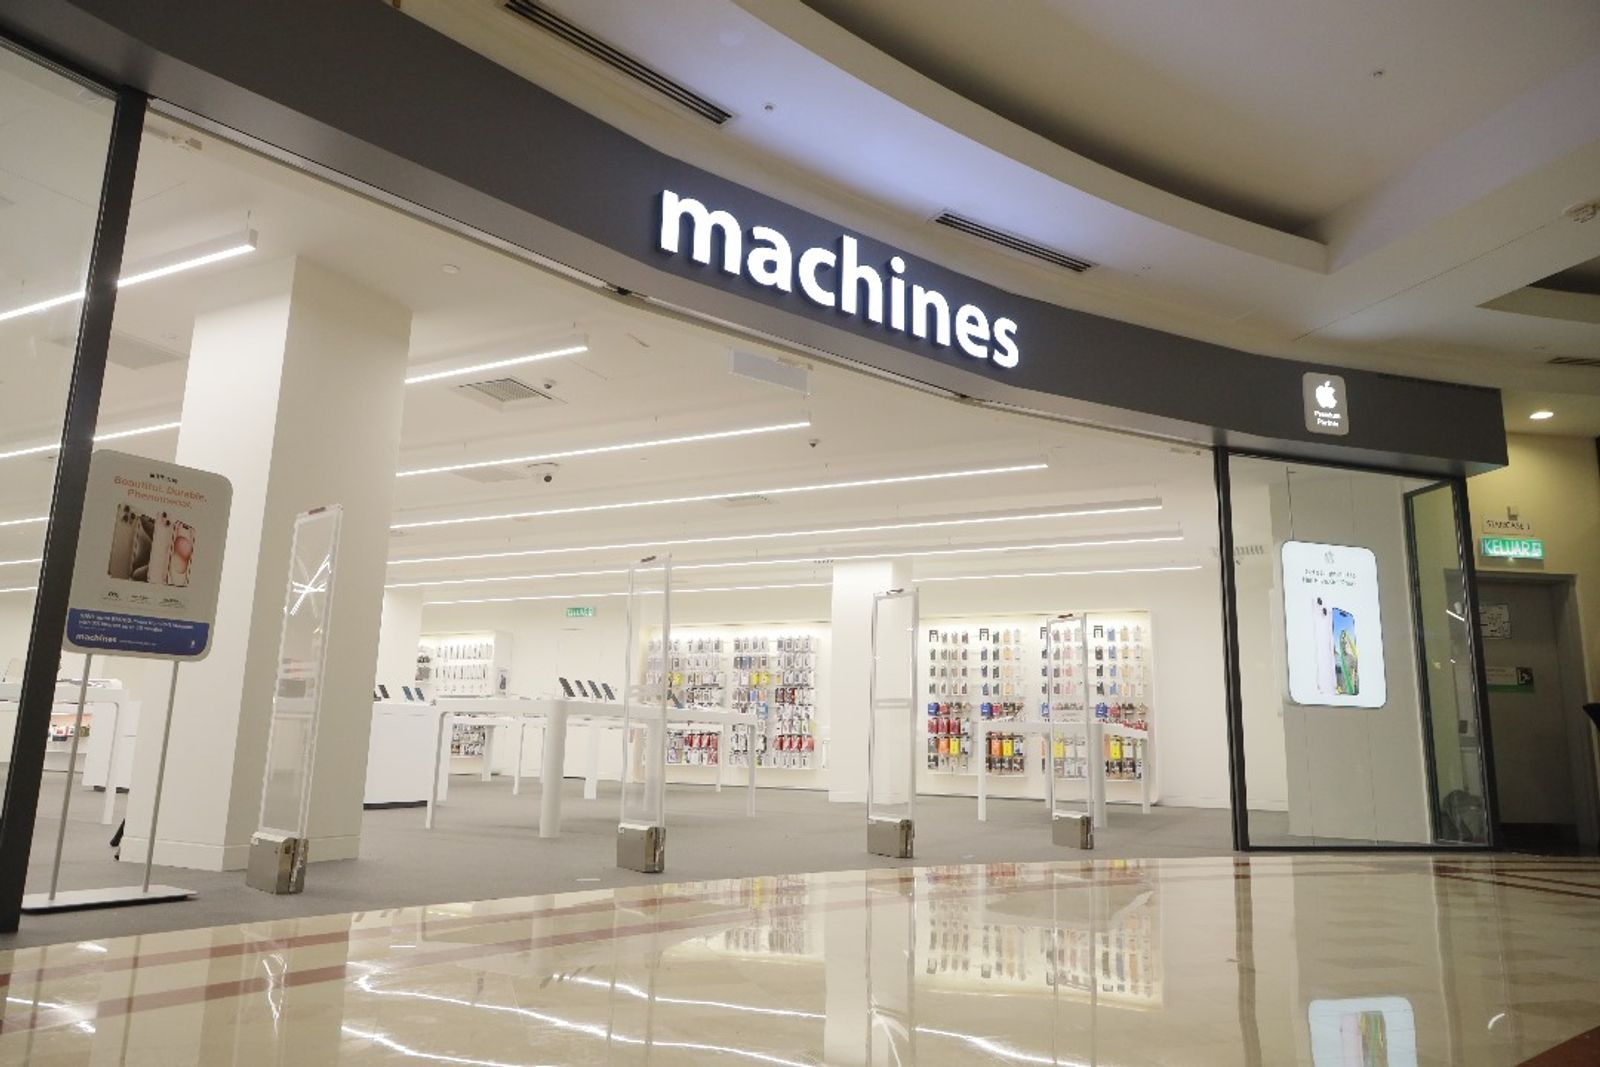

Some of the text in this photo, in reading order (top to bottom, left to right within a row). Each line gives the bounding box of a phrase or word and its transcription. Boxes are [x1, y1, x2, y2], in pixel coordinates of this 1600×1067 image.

[661, 190, 1019, 368] machines
[1484, 540, 1530, 557] KELUAR
[76, 633, 117, 643] machines
